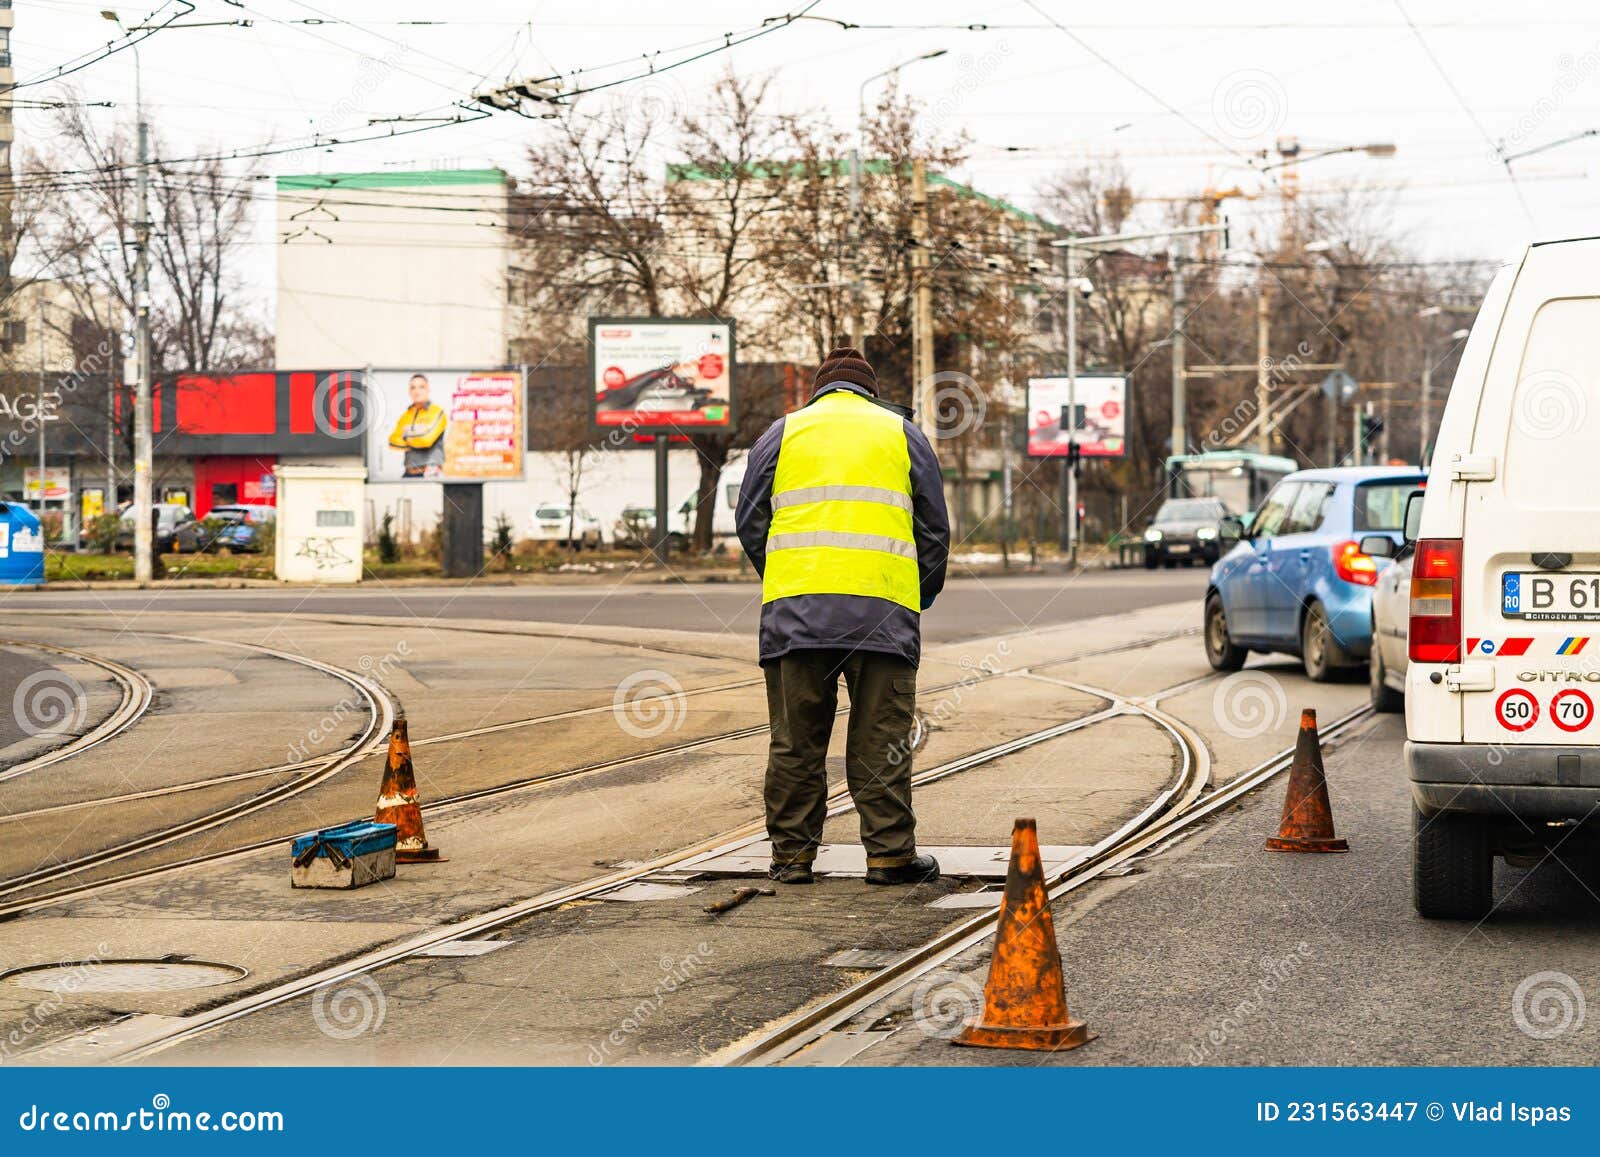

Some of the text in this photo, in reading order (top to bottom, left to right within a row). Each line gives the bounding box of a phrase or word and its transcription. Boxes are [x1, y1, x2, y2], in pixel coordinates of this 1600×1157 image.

[1532, 578, 1555, 608] B
[1505, 596, 1519, 608] RO
[1505, 702, 1529, 719] 50
[1560, 702, 1585, 719] 70
